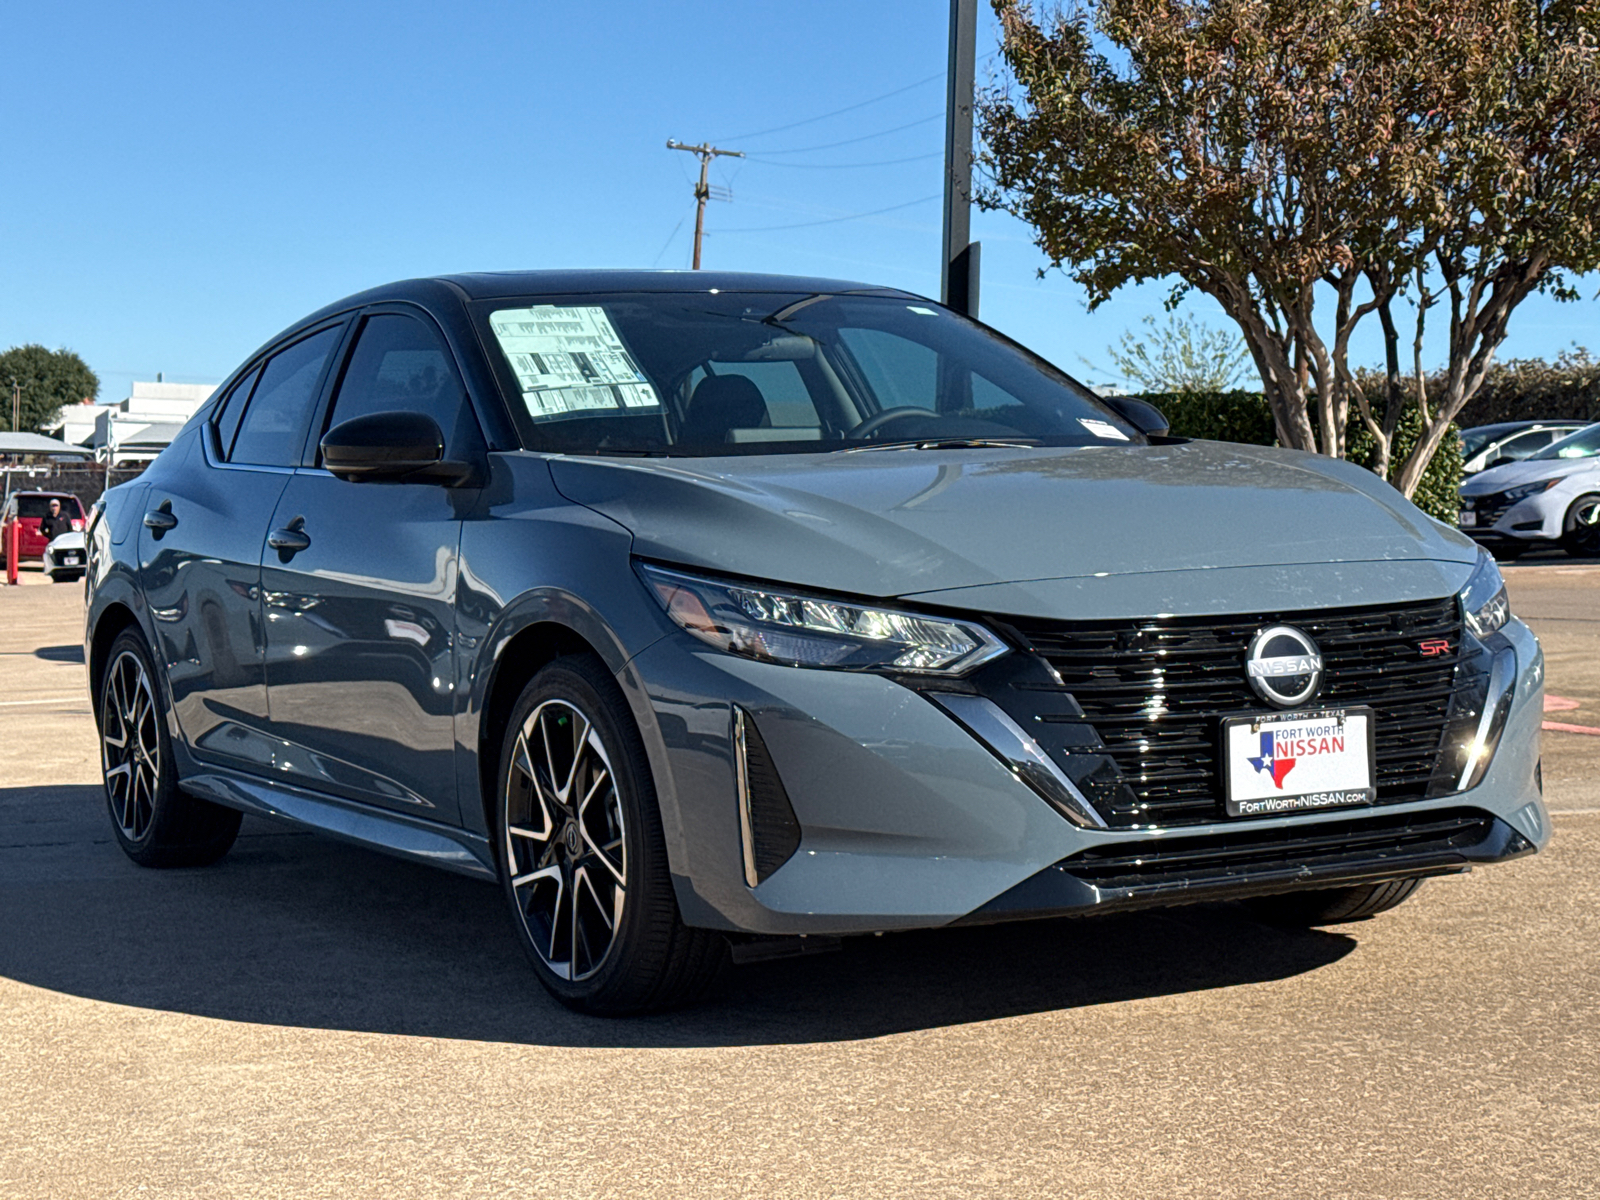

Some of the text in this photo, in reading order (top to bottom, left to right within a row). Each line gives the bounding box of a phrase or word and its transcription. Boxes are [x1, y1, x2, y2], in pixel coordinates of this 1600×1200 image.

[1420, 640, 1449, 656] SR
[1250, 657, 1321, 675] NISSAN
[1255, 709, 1346, 723] FORT WORTH TEXAS
[1275, 724, 1344, 740] FORT WORTH
[1276, 736, 1345, 758] NISSAN
